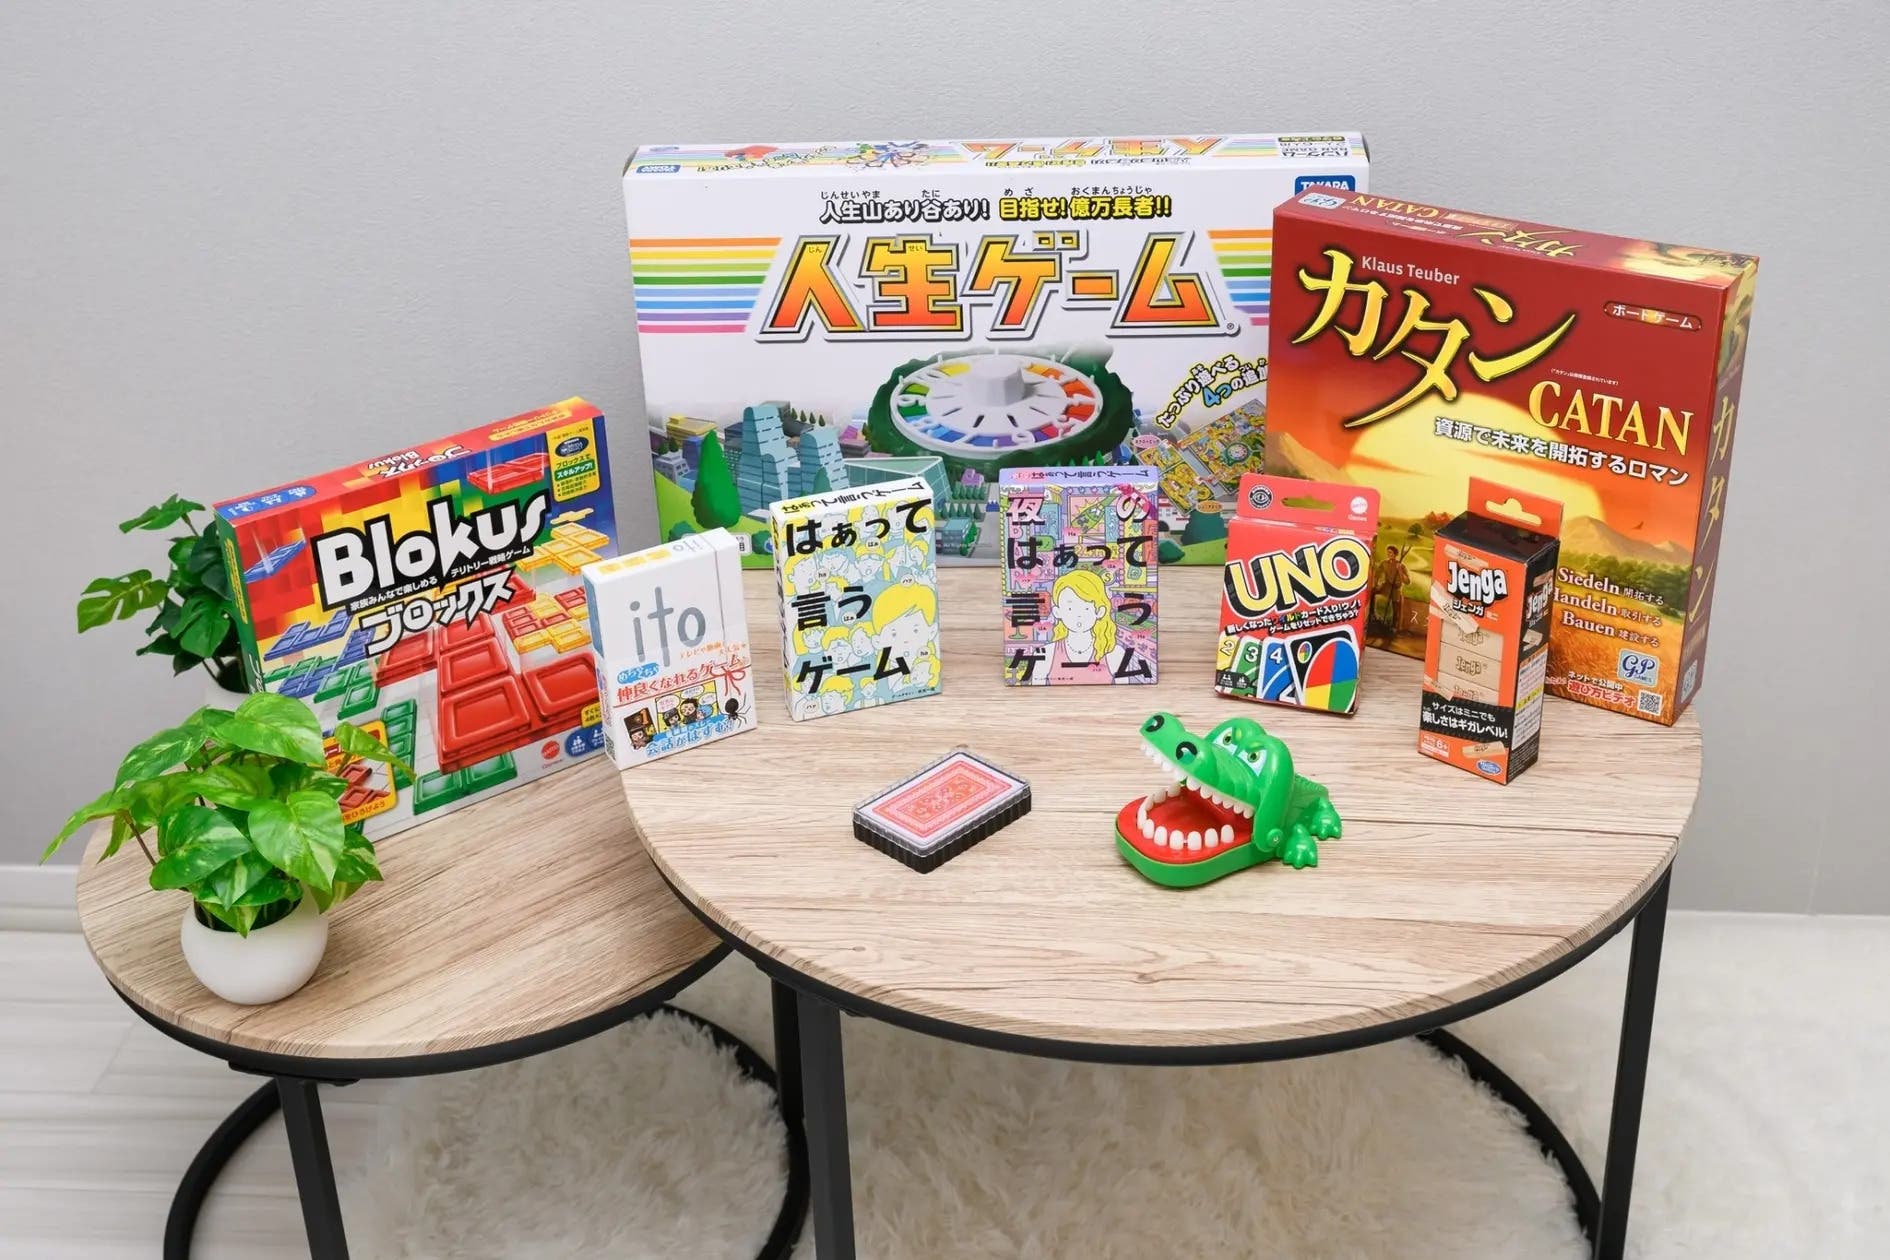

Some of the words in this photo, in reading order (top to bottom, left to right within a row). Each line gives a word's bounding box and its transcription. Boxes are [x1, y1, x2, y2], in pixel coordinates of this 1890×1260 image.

[921, 188, 941, 198] たに
[1003, 187, 1014, 197] め
[1024, 187, 1035, 196] ざ
[1071, 185, 1153, 196] おくまんちょうじゃ
[1349, 195, 1440, 219] CATAN
[819, 198, 991, 225] 人生山あり谷あり!
[999, 197, 1068, 220] 目指せ!
[1069, 194, 1172, 217] 億万長者!!
[1455, 230, 1585, 257] カタン
[758, 229, 1224, 334] 人生ゲーム
[1361, 255, 1404, 277] Klaus
[1407, 262, 1461, 287] Teuber
[1613, 304, 1693, 330] ボードゲーム
[1292, 249, 1577, 429] カタン
[1156, 354, 1241, 429] たっぷり遊べる
[1528, 380, 1695, 457] CATAN
[368, 449, 420, 471] Blokus
[382, 444, 472, 479] ブロックス
[1434, 416, 1690, 488] 資源で未来を開拓するロマン
[1009, 469, 1150, 481] はぁって言うゲーム
[785, 499, 932, 557] はぁって
[317, 493, 547, 606] Blokus
[1008, 535, 1154, 570] はぁって
[1225, 536, 1371, 617] UNO
[1446, 560, 1508, 605] Jenga
[1557, 566, 1621, 596] Siedeln
[350, 576, 438, 612] 家族みんなで楽しめる
[791, 585, 872, 632] 言う
[1005, 592, 1152, 628] 言う
[1452, 598, 1485, 618] ジェンガ
[360, 567, 516, 658] ブロックス
[629, 586, 707, 668] ito
[1562, 609, 1616, 638] Bauen
[1008, 646, 1153, 682] ゲーム
[1220, 640, 1236, 657] 2
[1245, 646, 1260, 663] 3
[1269, 647, 1284, 665] 4
[796, 646, 911, 695] ゲーム
[1455, 655, 1481, 677] Jenga
[1421, 709, 1509, 739] 楽しさはギガレベル!
[1431, 701, 1497, 723] サイズはミニでも
[343, 800, 385, 821] ひろげよう
